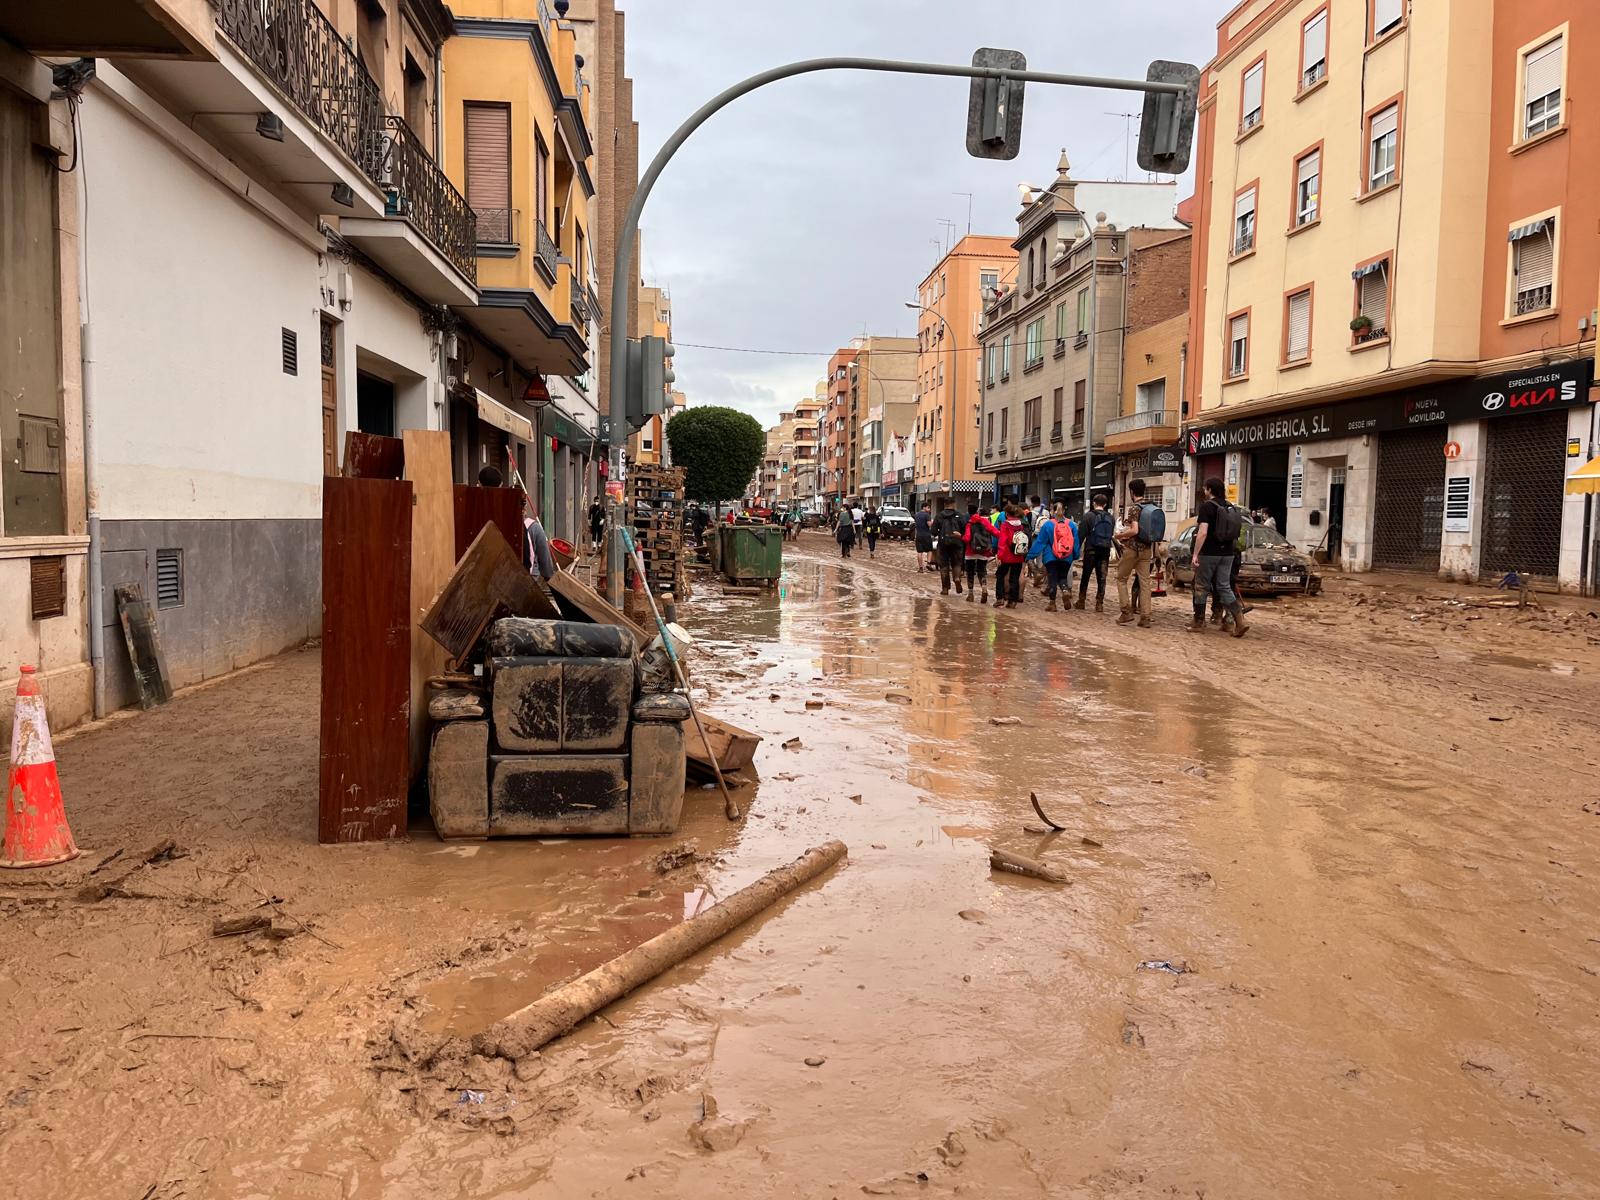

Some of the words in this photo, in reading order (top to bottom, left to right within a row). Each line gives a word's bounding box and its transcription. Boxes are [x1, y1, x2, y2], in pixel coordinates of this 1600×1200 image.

[1508, 374, 1550, 388] ESPECIALISTAS
[1551, 372, 1561, 381] EN
[1415, 399, 1438, 409] NUEVA
[1408, 411, 1446, 423] MOVILIDAD
[1347, 420, 1365, 430] DESDE
[1200, 430, 1227, 449] ARSAN
[1229, 425, 1264, 445] MOTOR
[1312, 415, 1331, 434] S.L.
